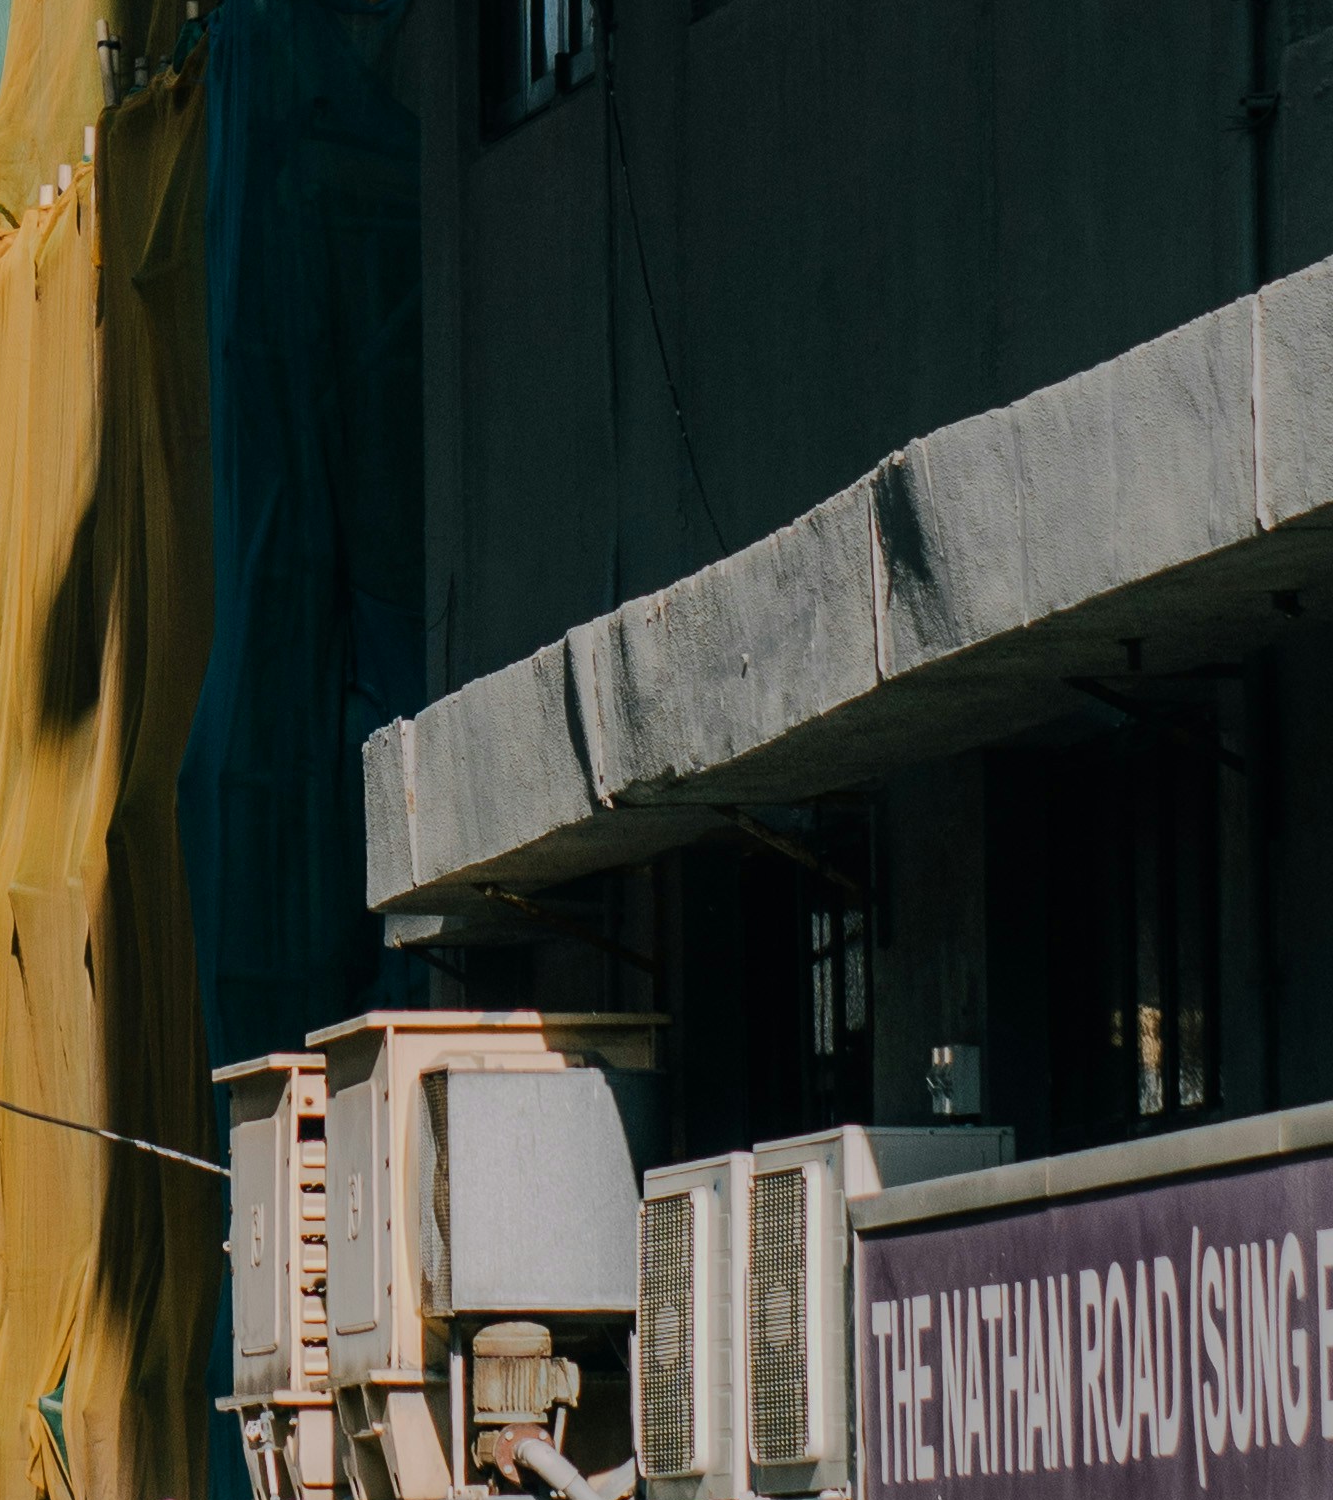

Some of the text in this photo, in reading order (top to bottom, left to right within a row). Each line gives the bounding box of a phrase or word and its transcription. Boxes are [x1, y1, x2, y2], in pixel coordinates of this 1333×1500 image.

[871, 1294, 935, 1485] THE
[940, 1273, 1075, 1478] NATHAN
[1079, 1255, 1182, 1468] ROAD
[1189, 1226, 1309, 1489] (SUNG
